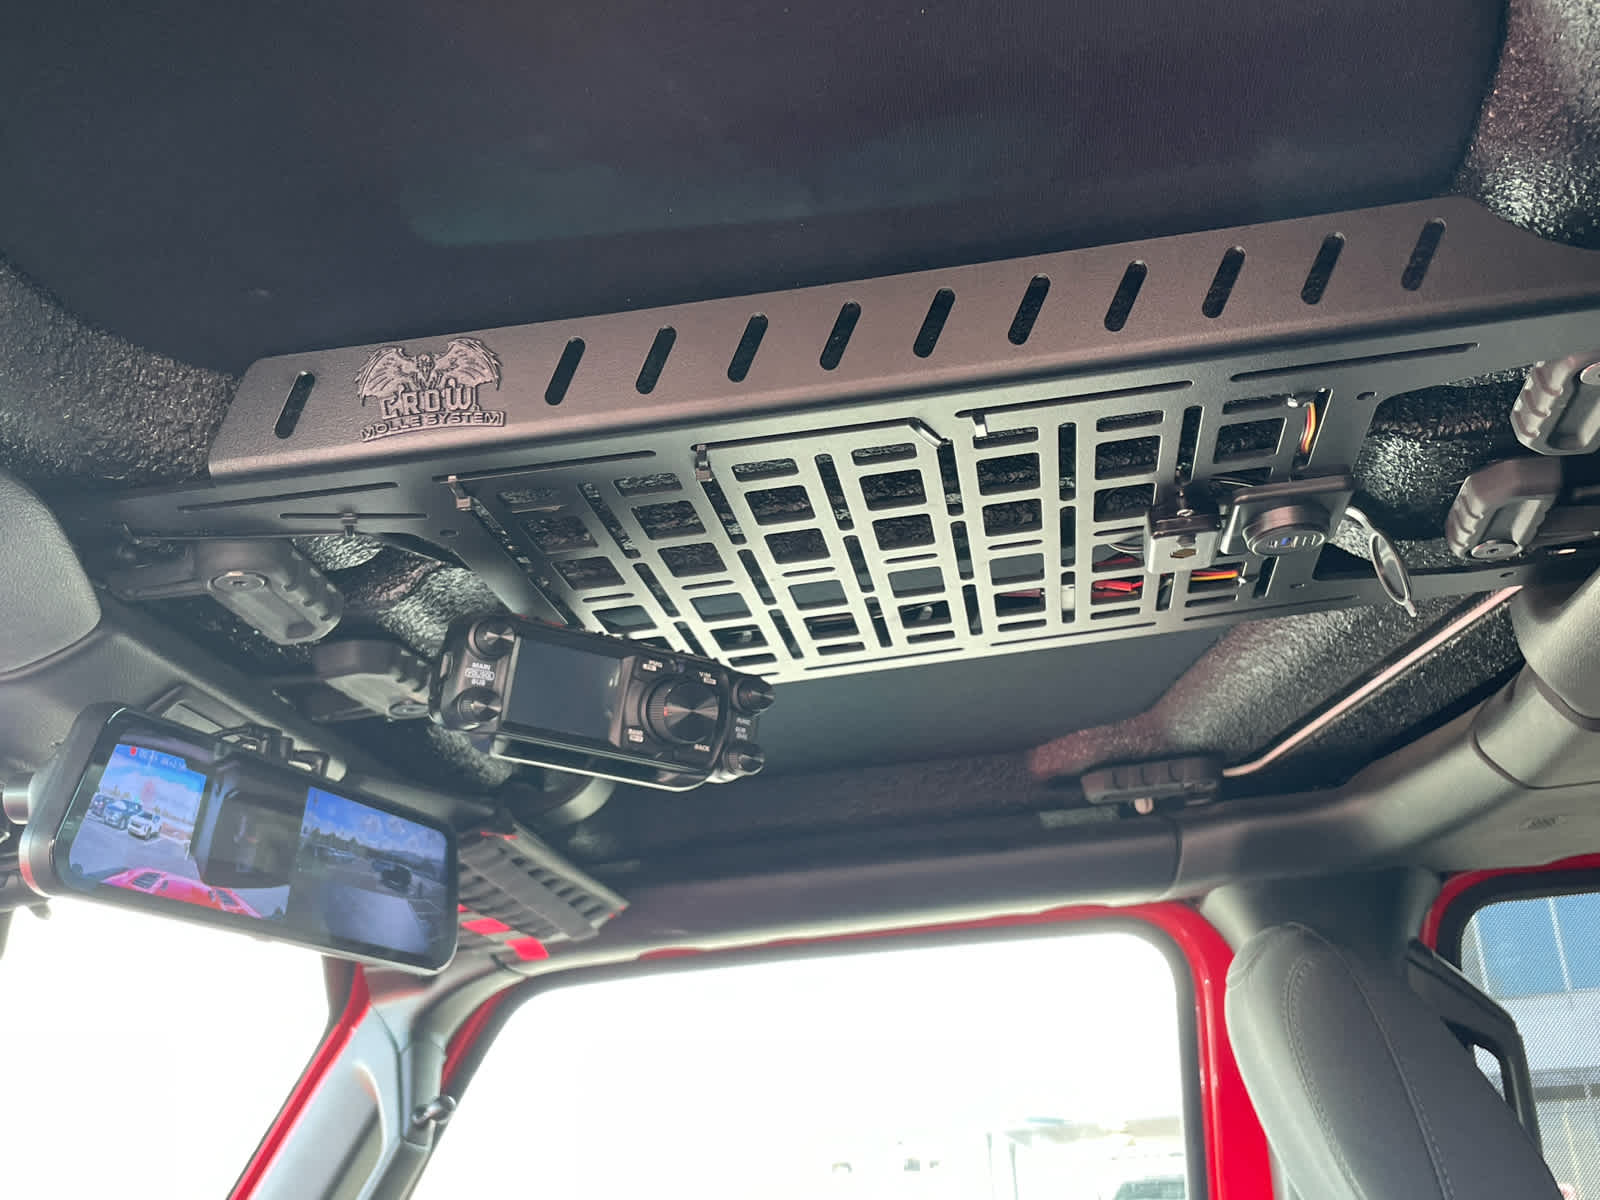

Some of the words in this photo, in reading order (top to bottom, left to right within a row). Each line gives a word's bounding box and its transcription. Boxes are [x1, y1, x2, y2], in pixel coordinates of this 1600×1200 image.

[380, 384, 475, 420] CROW
[361, 415, 423, 440] MOLLE
[427, 411, 502, 426] SYSTEM
[471, 662, 491, 671] MAIN
